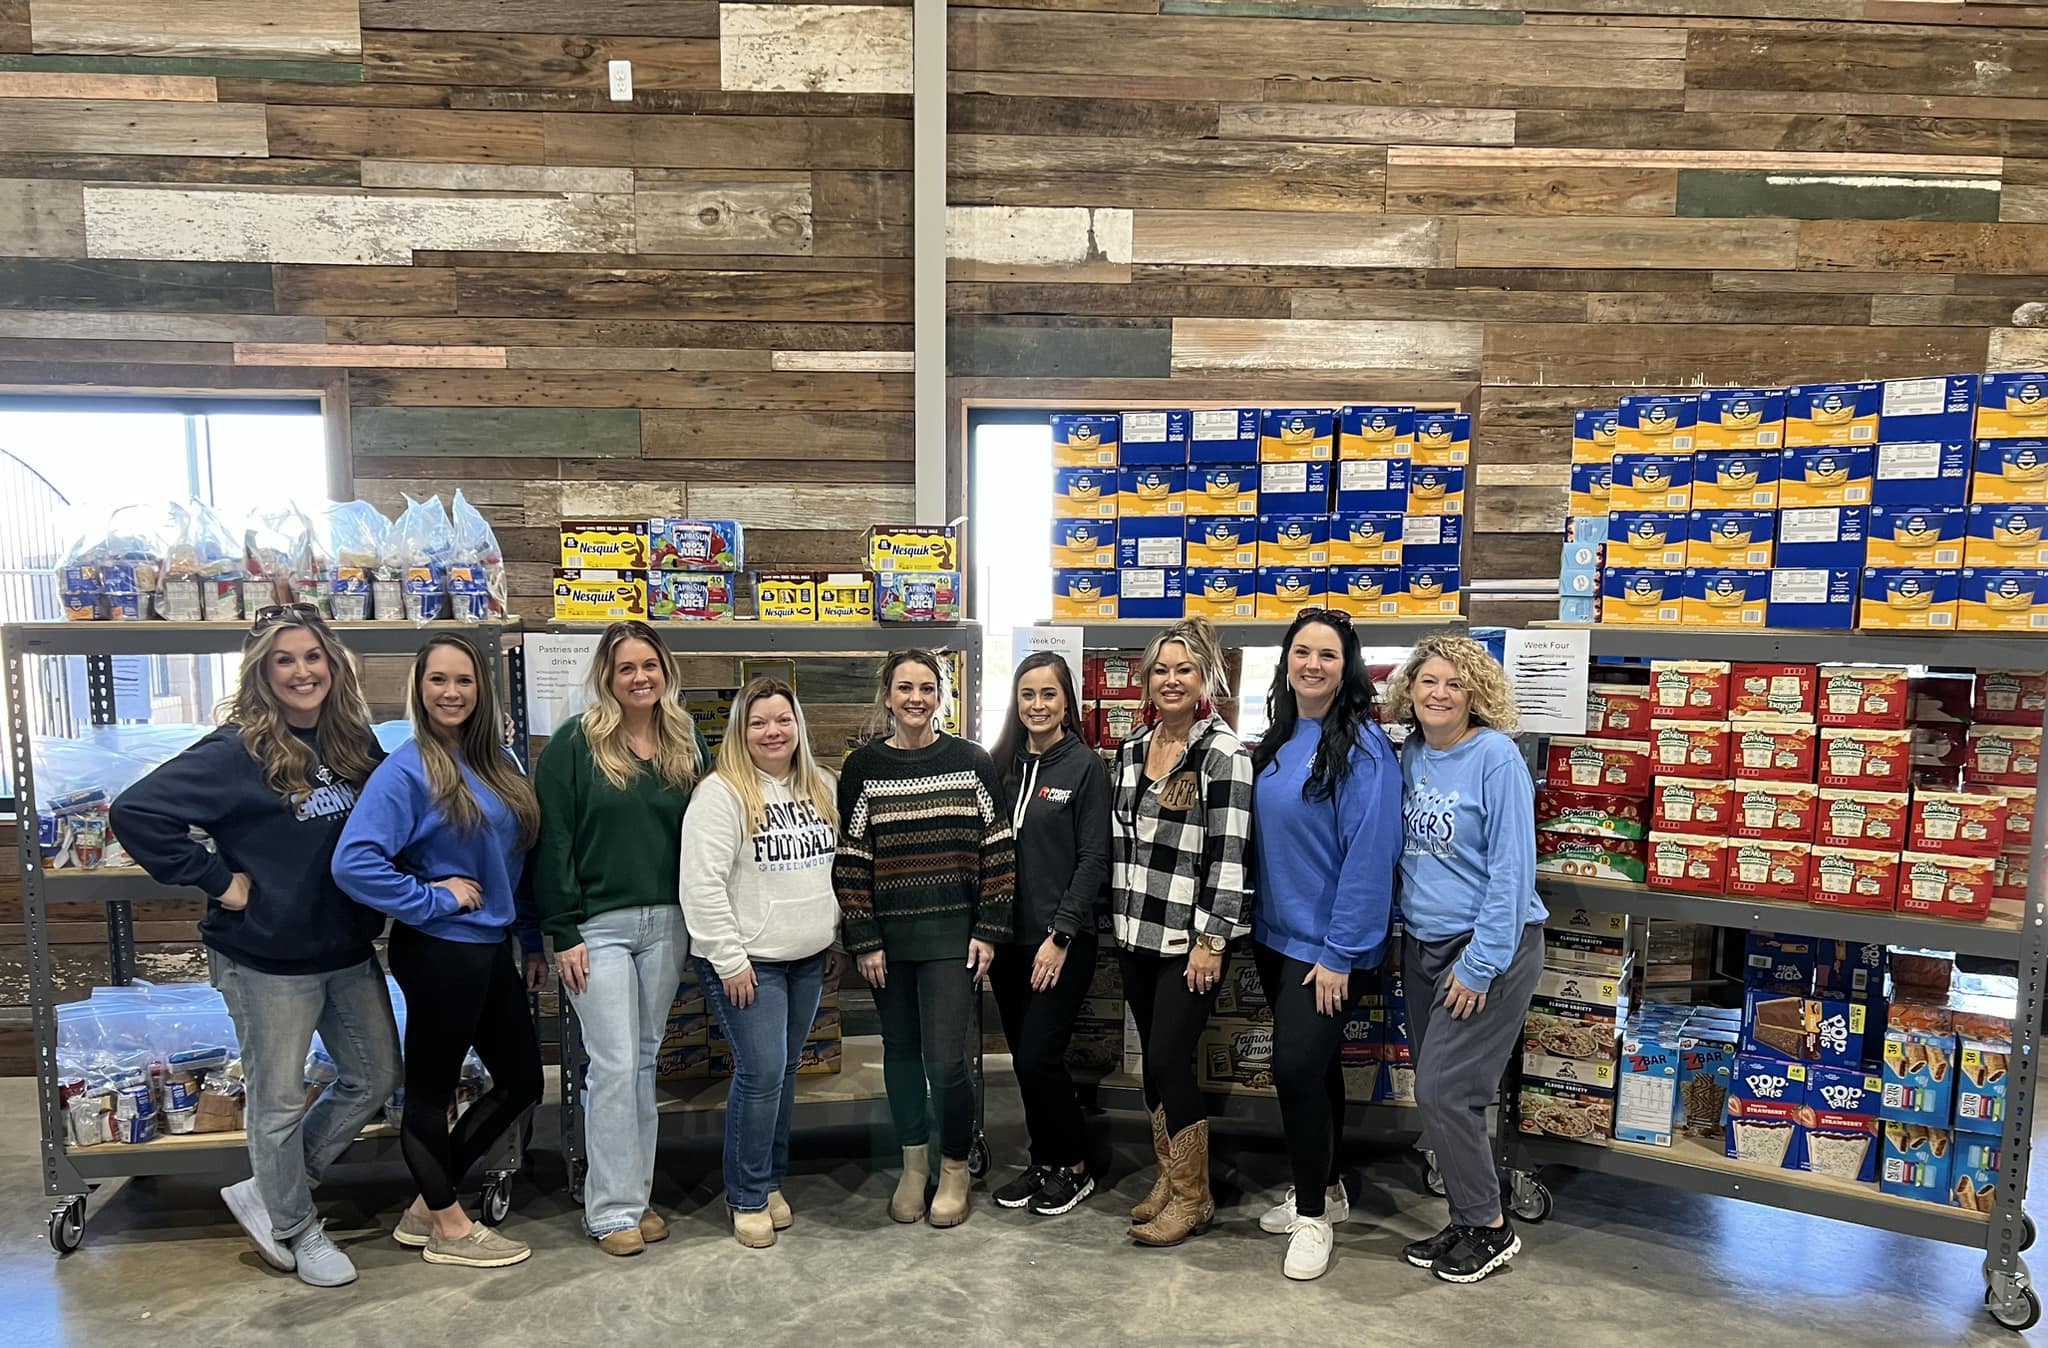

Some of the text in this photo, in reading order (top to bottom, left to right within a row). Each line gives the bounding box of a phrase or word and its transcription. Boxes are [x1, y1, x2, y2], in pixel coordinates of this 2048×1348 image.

[580, 543, 619, 556] Nesquik
[678, 548, 706, 557] JUICE
[892, 544, 929, 557] Nesquik
[710, 576, 722, 584] 40
[937, 577, 949, 585] 40
[573, 589, 616, 605] Nesquik
[676, 599, 705, 608] JUICE
[906, 600, 934, 609] JUICE
[765, 607, 794, 618] Nesquik
[824, 607, 854, 617] Nesquik
[1028, 637, 1066, 645] Week One
[1523, 641, 1570, 650] Week Four
[538, 645, 590, 654] Pastries and
[551, 658, 577, 666] drinks
[690, 709, 715, 723] quik
[291, 783, 356, 821] GREENW
[753, 828, 836, 862] FOOTBALL
[770, 856, 834, 872] GREENWOOD
[1610, 917, 1621, 927] 52
[1602, 985, 1613, 995] 52
[1231, 1031, 1273, 1048] Famou
[1598, 1067, 1608, 1077] 52
[1752, 1086, 1783, 1099] tarts
[1828, 1096, 1859, 1110] tarts
[1746, 1107, 1787, 1116] STRAWBERRY
[1821, 1118, 1863, 1128] STRAWBERRY
